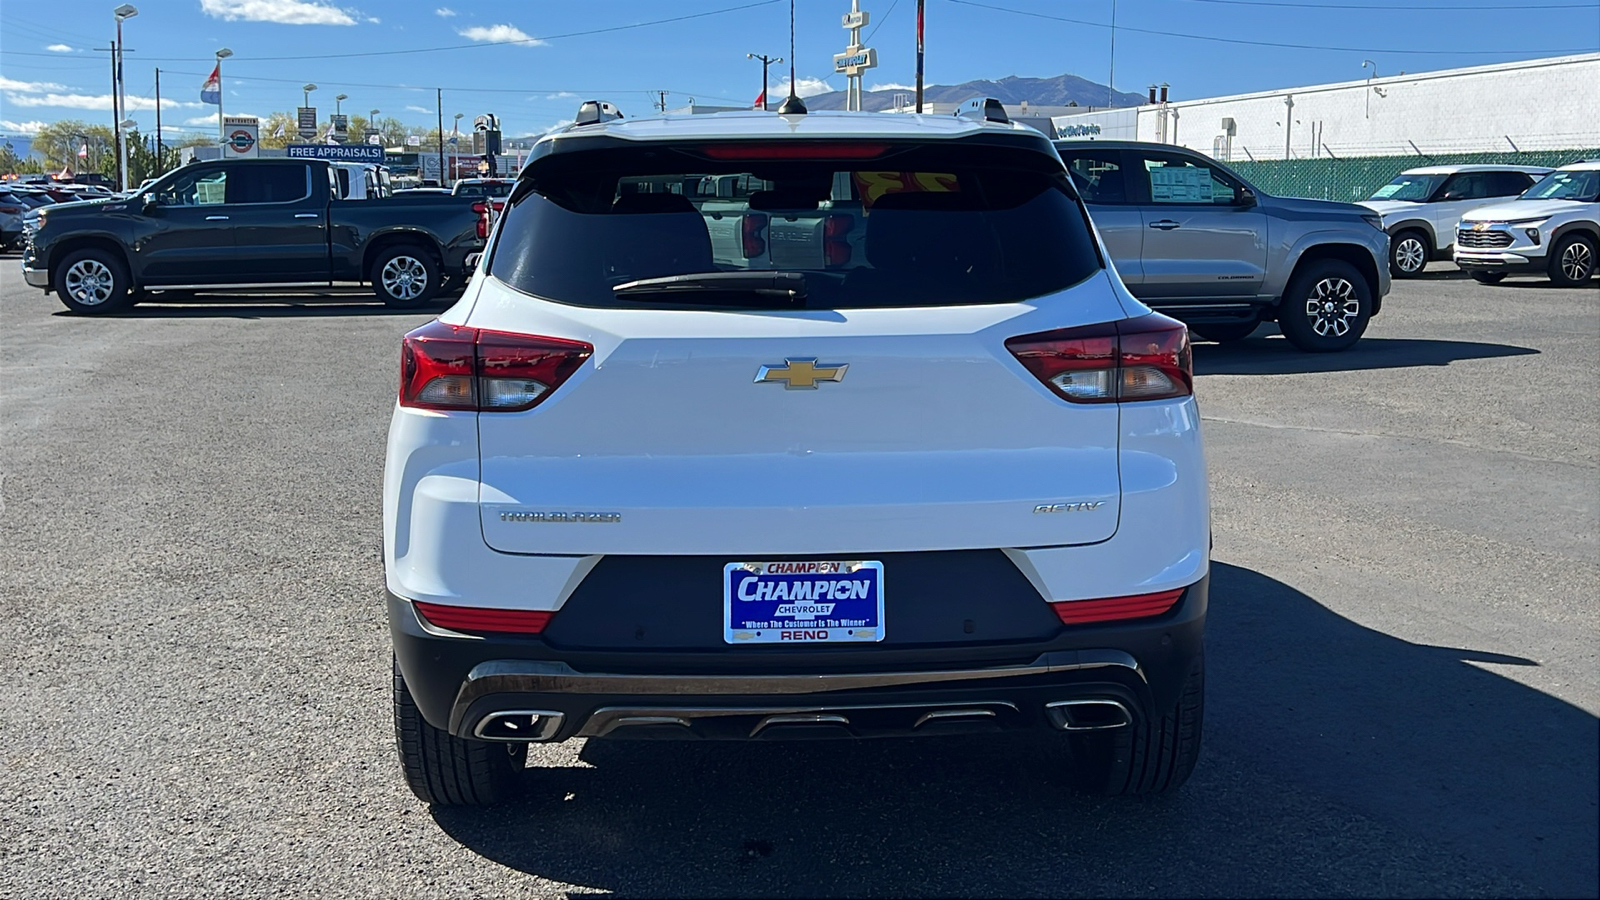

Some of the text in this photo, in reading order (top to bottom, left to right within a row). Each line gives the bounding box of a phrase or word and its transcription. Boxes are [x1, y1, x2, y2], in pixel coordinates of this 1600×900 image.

[290, 147, 382, 158] FREE APPRAISALS!
[499, 511, 622, 522] TRAILBLAZER
[767, 562, 841, 574] CHAMPION
[737, 576, 871, 602] CHAMPION
[778, 605, 832, 614] CHEVROLET
[770, 620, 783, 629] The
[784, 619, 818, 628] Customer
[827, 619, 840, 628] The
[780, 630, 829, 641] RENO
